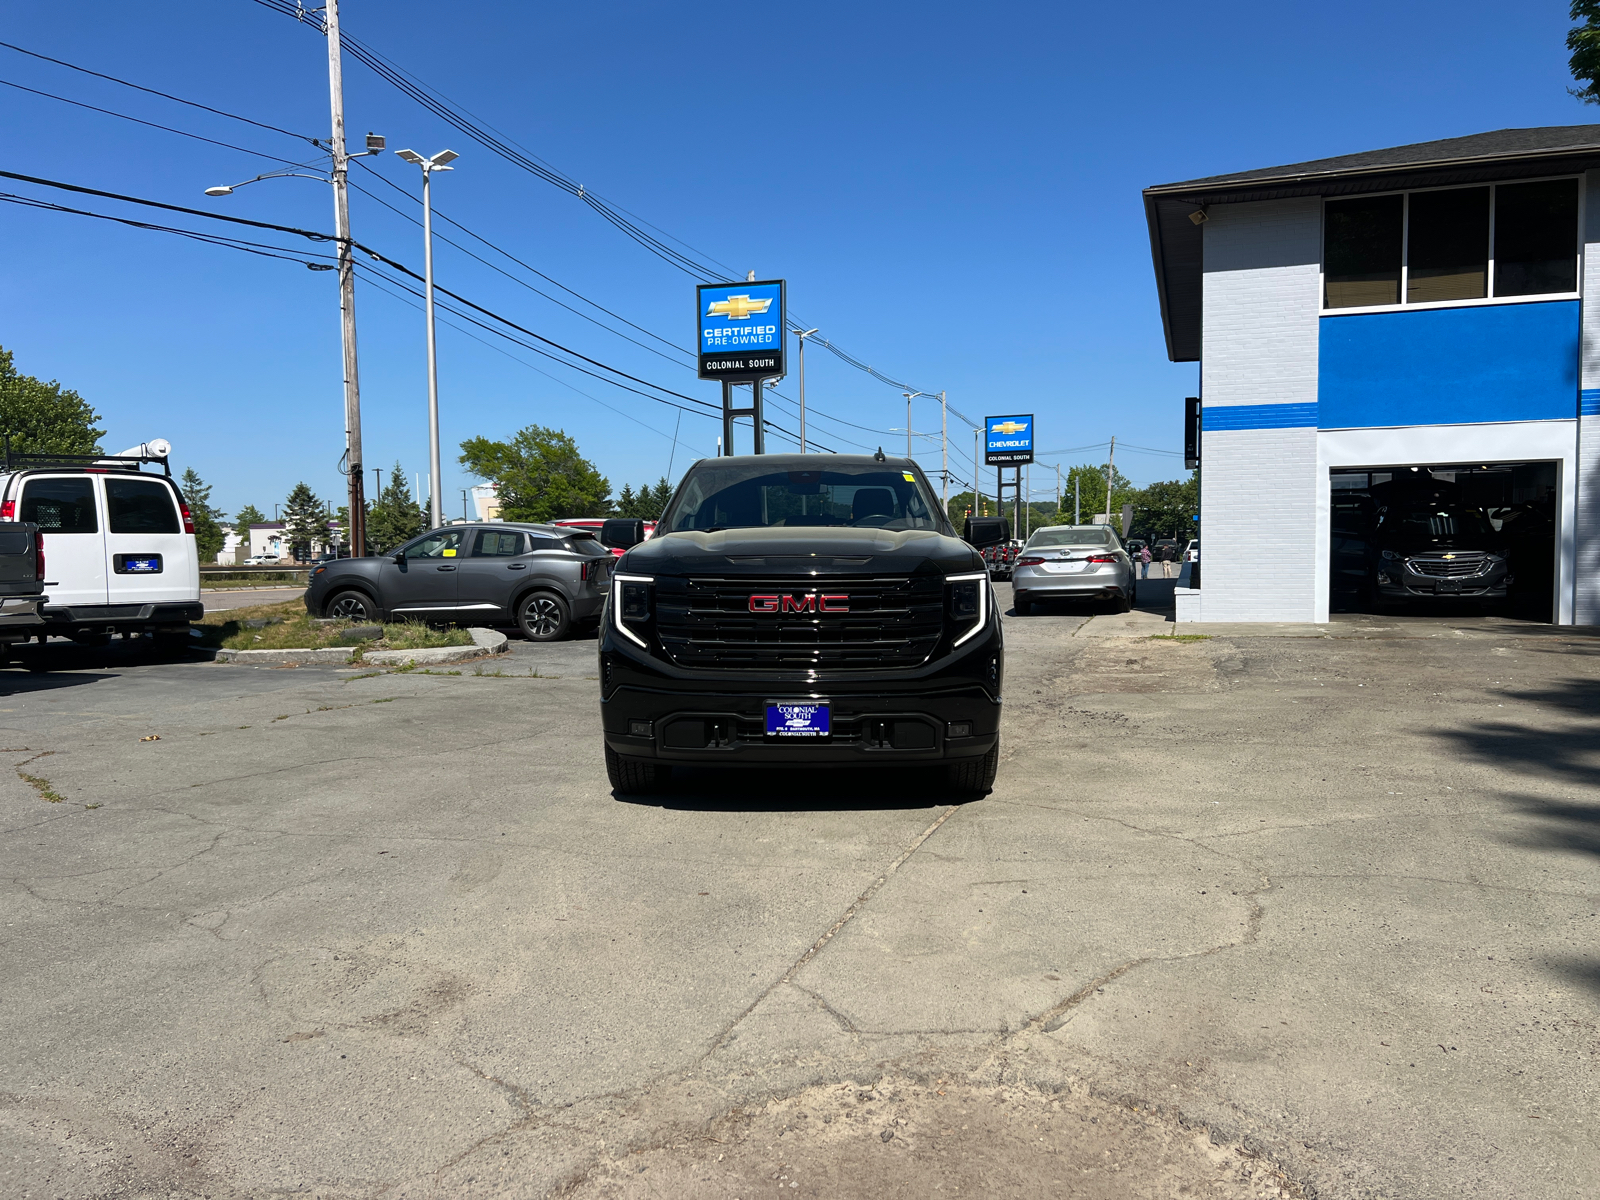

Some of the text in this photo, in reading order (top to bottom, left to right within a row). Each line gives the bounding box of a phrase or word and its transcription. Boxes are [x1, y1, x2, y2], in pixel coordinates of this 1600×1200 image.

[704, 325, 776, 337] CERTIFIED
[707, 335, 772, 346] PRE-OWNED
[706, 358, 775, 370] COLONIAL SOUTH
[989, 440, 1030, 448] CHEVROLET
[748, 593, 850, 613] GMC
